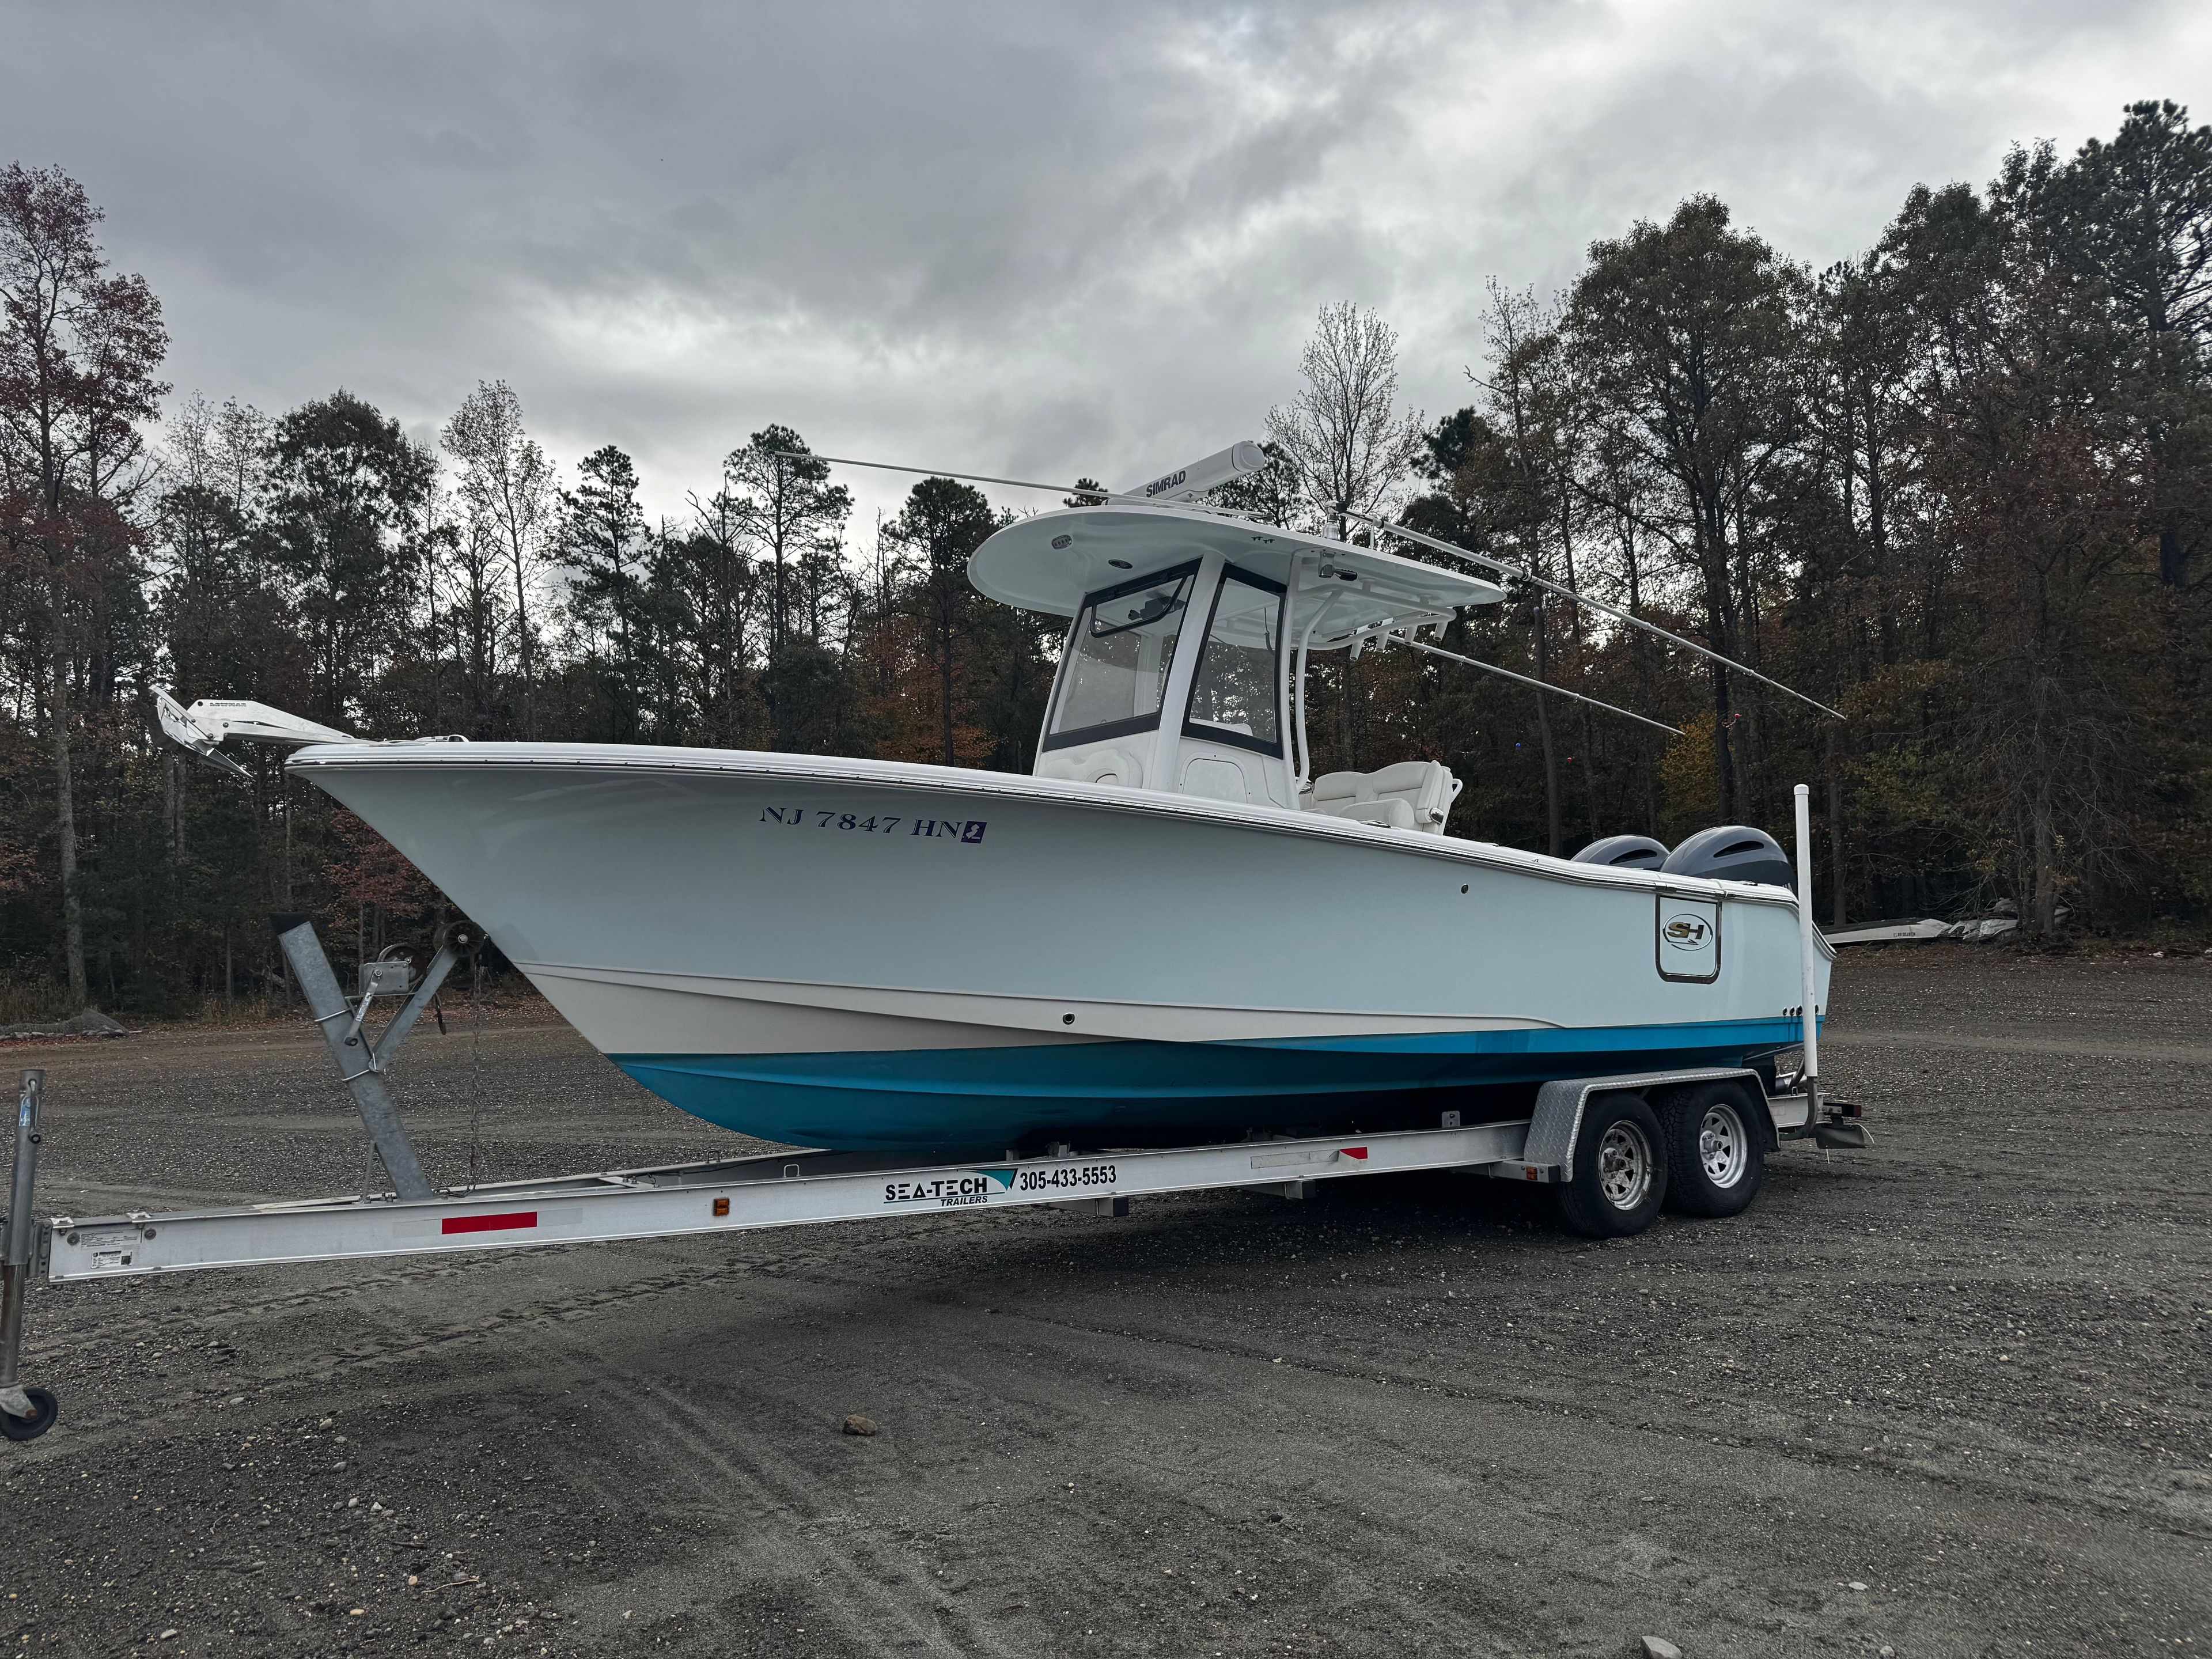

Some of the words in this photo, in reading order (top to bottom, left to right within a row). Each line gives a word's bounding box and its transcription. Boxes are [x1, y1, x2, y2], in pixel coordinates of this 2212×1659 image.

[1146, 470, 1186, 498] SIMRAD
[759, 806, 804, 825] NJ
[816, 811, 902, 834] 7847
[910, 819, 963, 839] HN
[1666, 922, 1705, 940] SH
[885, 1177, 987, 1201] SEA-TECH
[1020, 1165, 1116, 1191] 305-433-5553
[941, 1195, 988, 1207] TRAILERS
